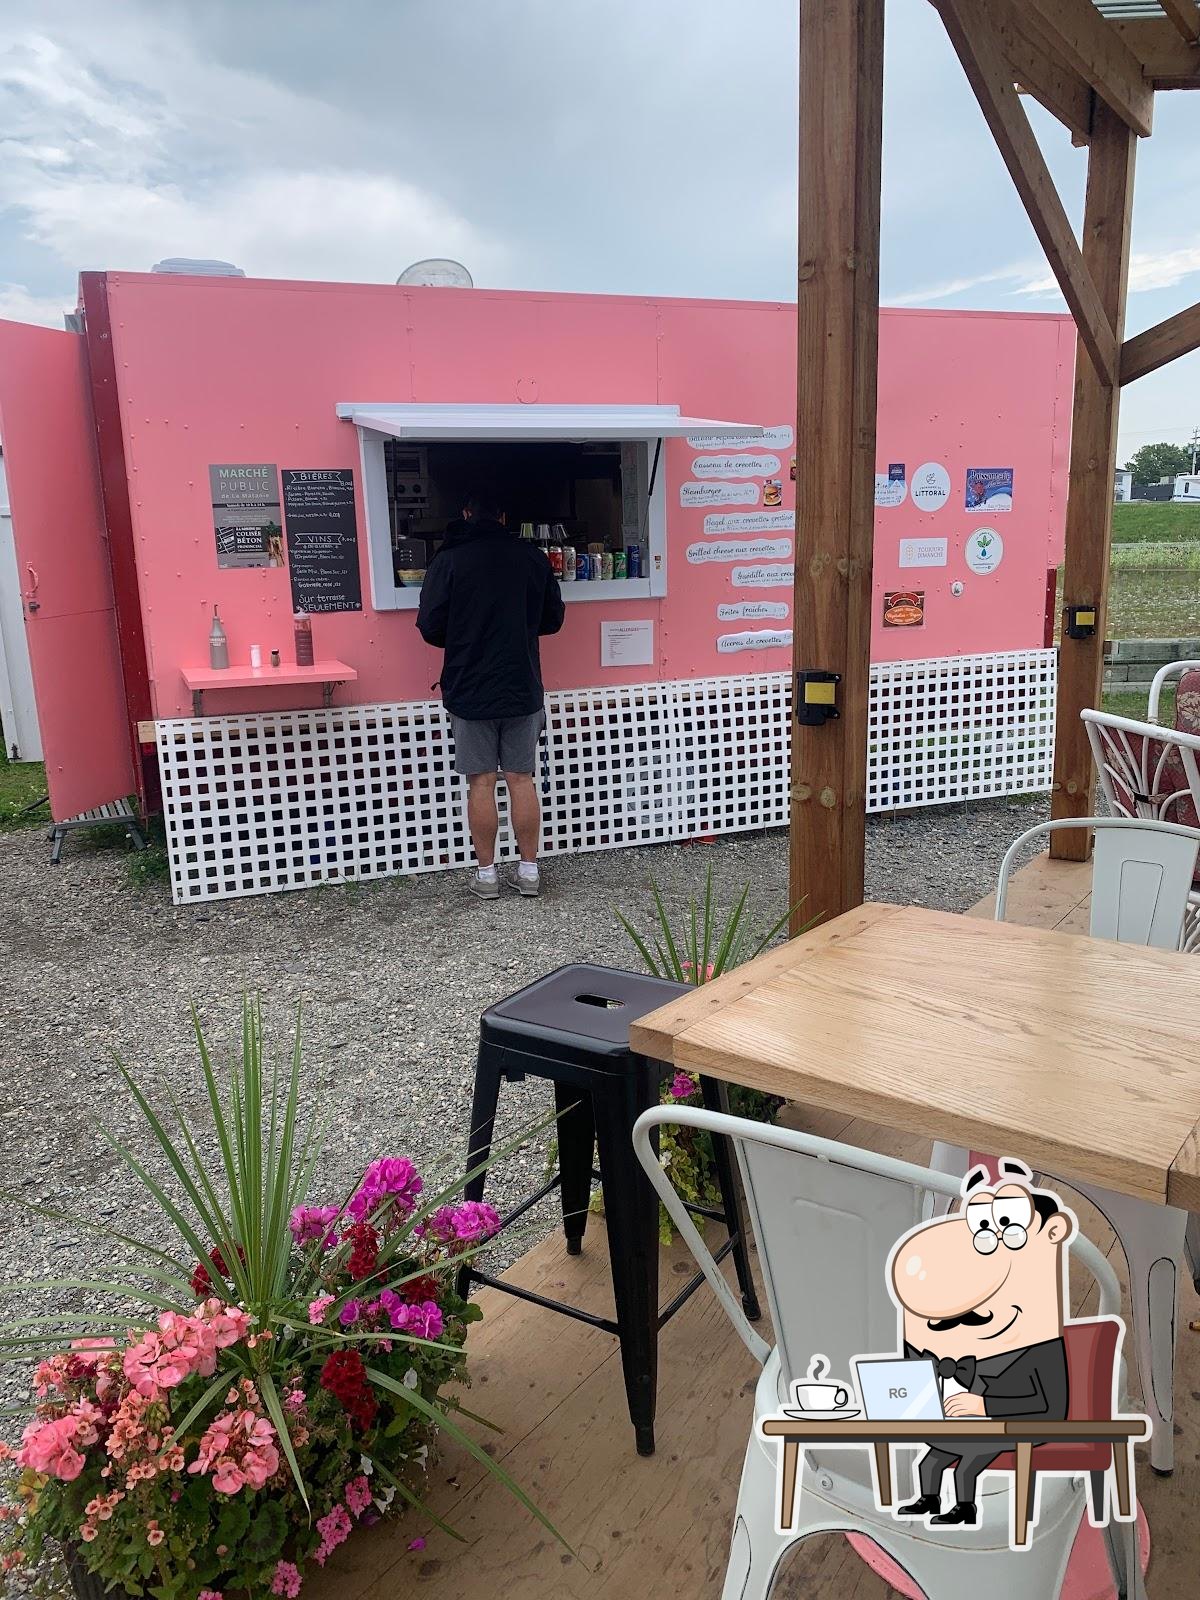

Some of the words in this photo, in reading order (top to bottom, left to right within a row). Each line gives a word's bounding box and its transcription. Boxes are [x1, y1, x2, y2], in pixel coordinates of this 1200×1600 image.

[219, 466, 268, 478] MARCHÉ
[300, 472, 333, 480] BIÈRES
[220, 481, 269, 491] PUBLIC
[307, 535, 332, 543] VINS
[299, 594, 315, 604] Sur
[303, 601, 356, 612] SEULEMENT
